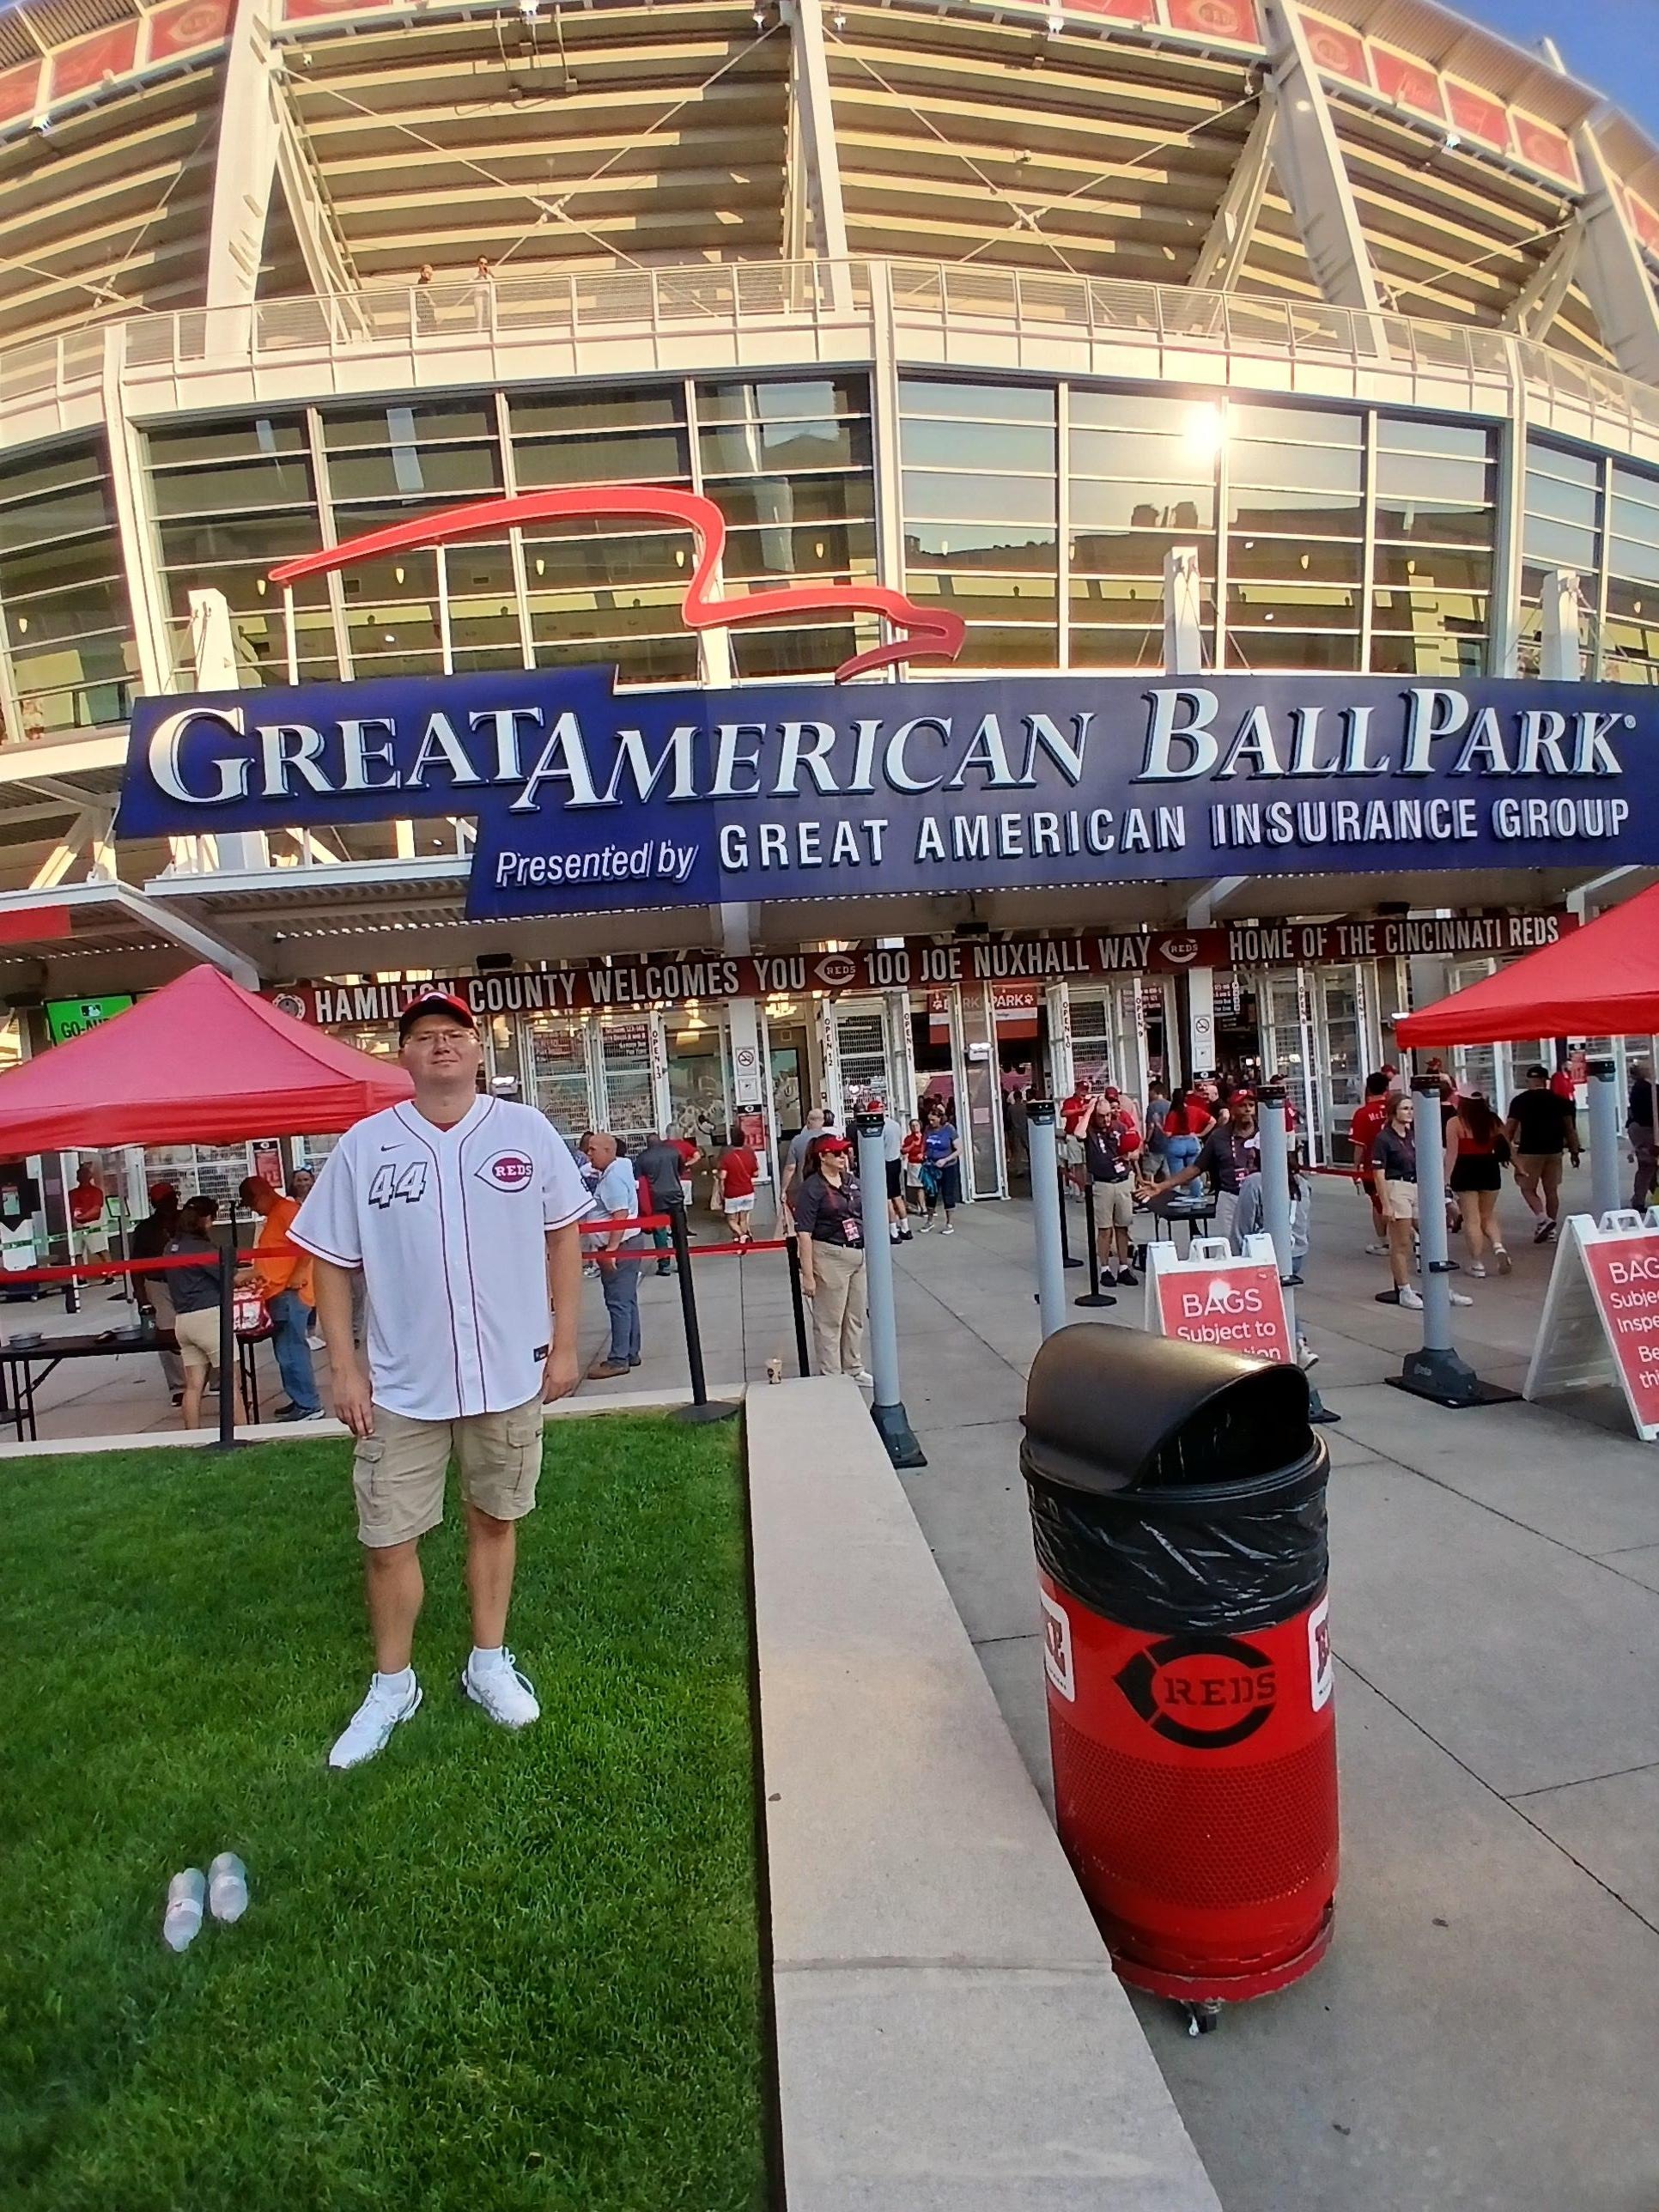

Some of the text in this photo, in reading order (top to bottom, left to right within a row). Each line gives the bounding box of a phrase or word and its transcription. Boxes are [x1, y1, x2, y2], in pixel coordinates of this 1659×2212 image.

[148, 706, 544, 805] GREAT
[508, 712, 1099, 812] AMERICAN
[1129, 687, 1390, 784] BALL
[495, 797, 1630, 890] Presented by GREAT AMERICAN INSURANCE GROUP
[315, 915, 1559, 1024] HAMILT COUNTY WELCOMES YOU REDS 100 JOE NUXHALL WAY REDS HOME OF THE CINCINNATI REDS
[368, 1161, 428, 1209] 44
[494, 1164, 533, 1177] REDS
[1608, 1256, 1659, 1285] BAG
[1182, 1288, 1263, 1318] BAGS
[1610, 1288, 1659, 1310] Subje
[1177, 1320, 1276, 1345] Subject to
[1164, 1670, 1277, 1706] REDS
